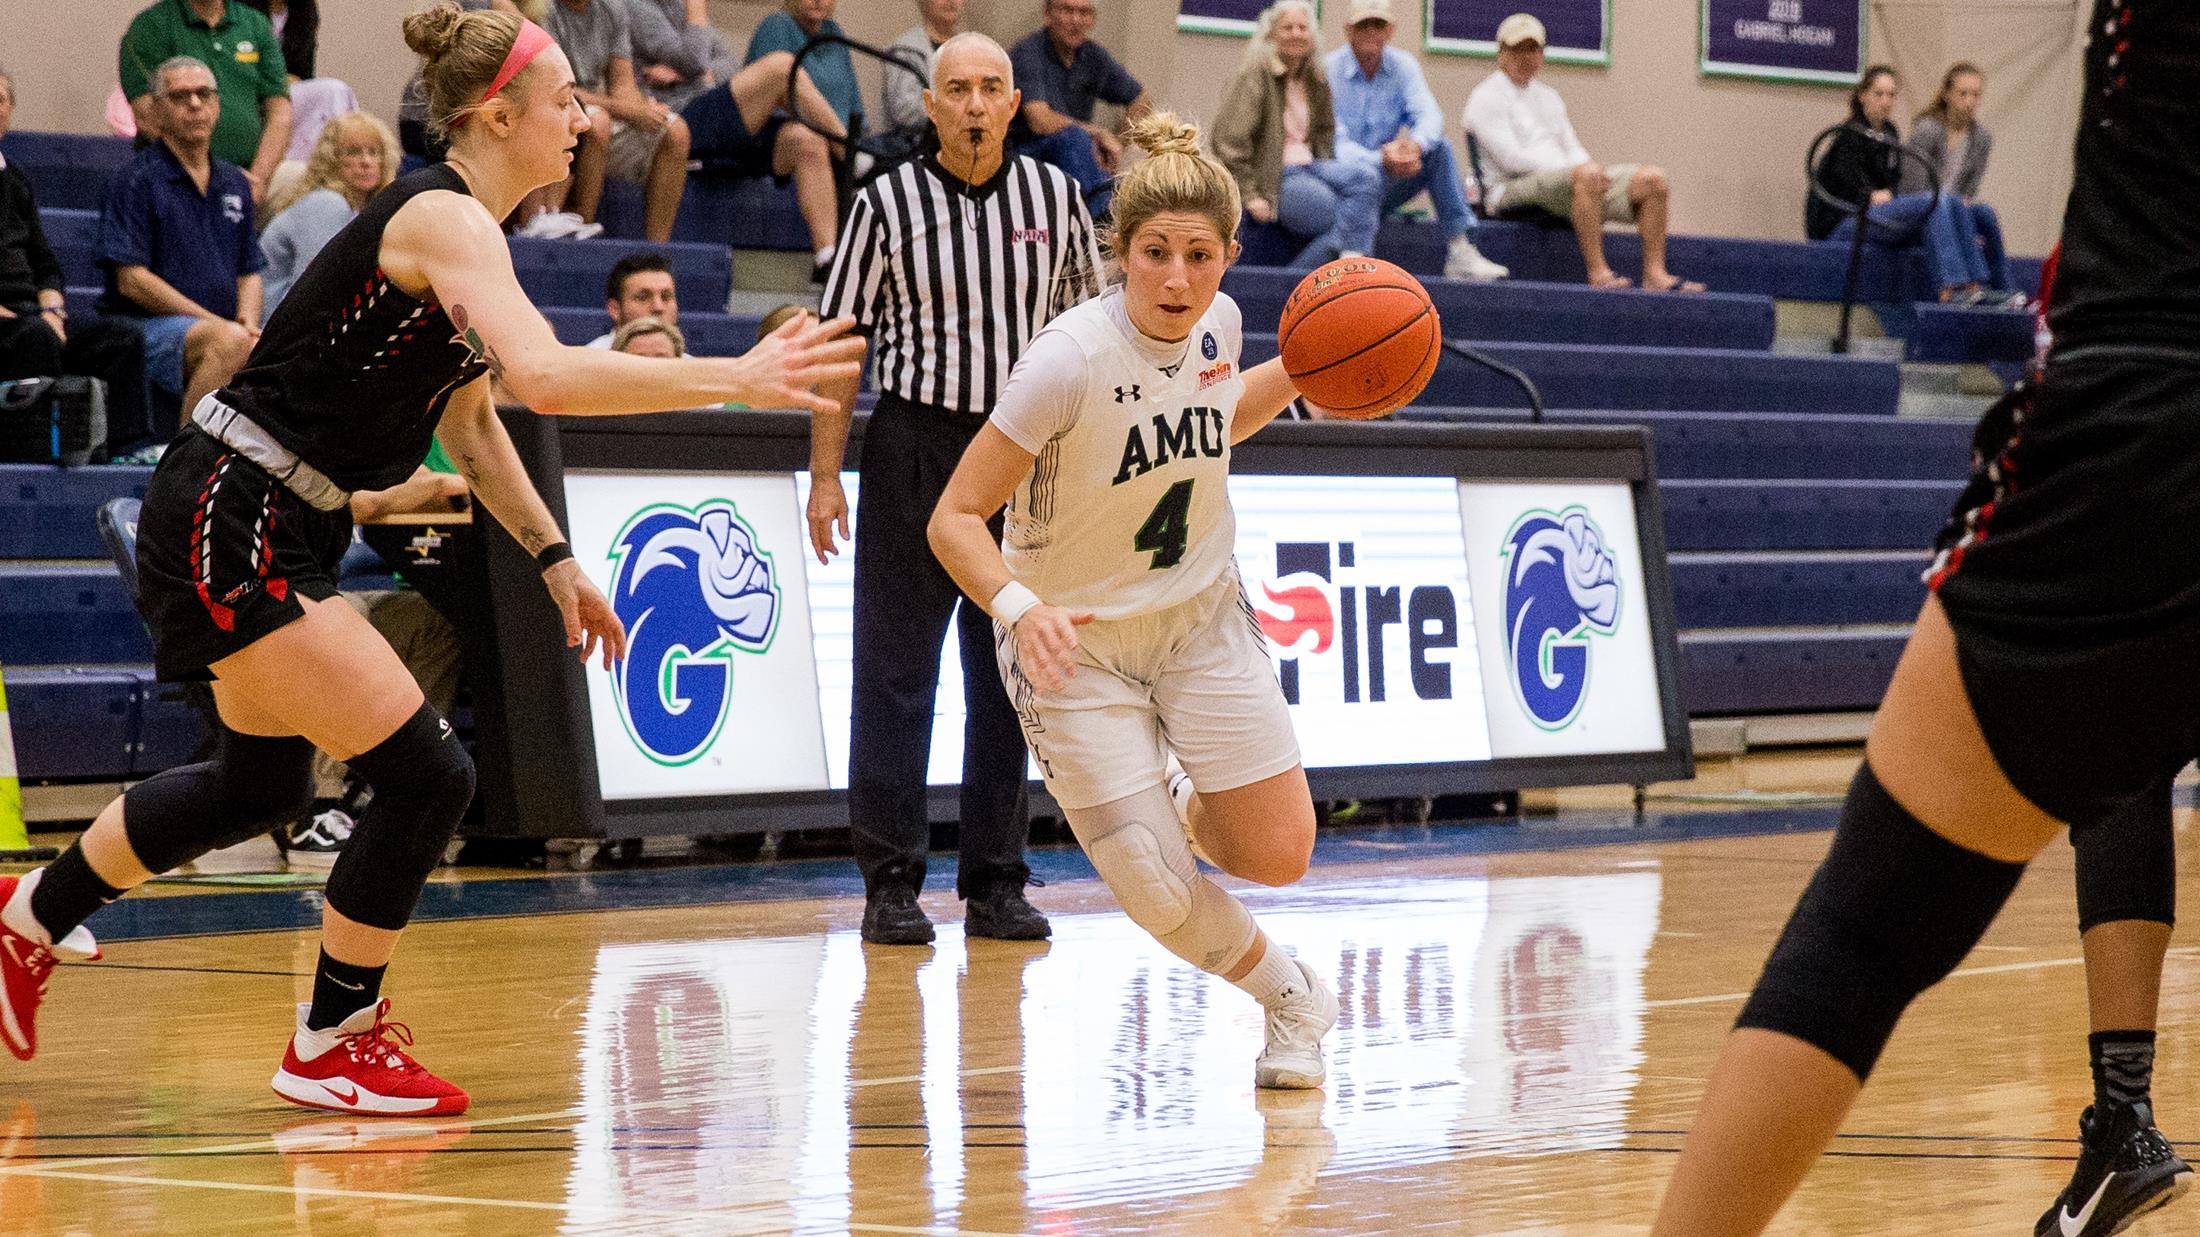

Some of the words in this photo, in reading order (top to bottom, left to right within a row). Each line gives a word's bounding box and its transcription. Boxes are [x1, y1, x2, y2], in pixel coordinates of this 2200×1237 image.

[1012, 229, 1050, 245] NAIA
[1111, 406, 1225, 487] AMU
[1134, 477, 1195, 571] 4
